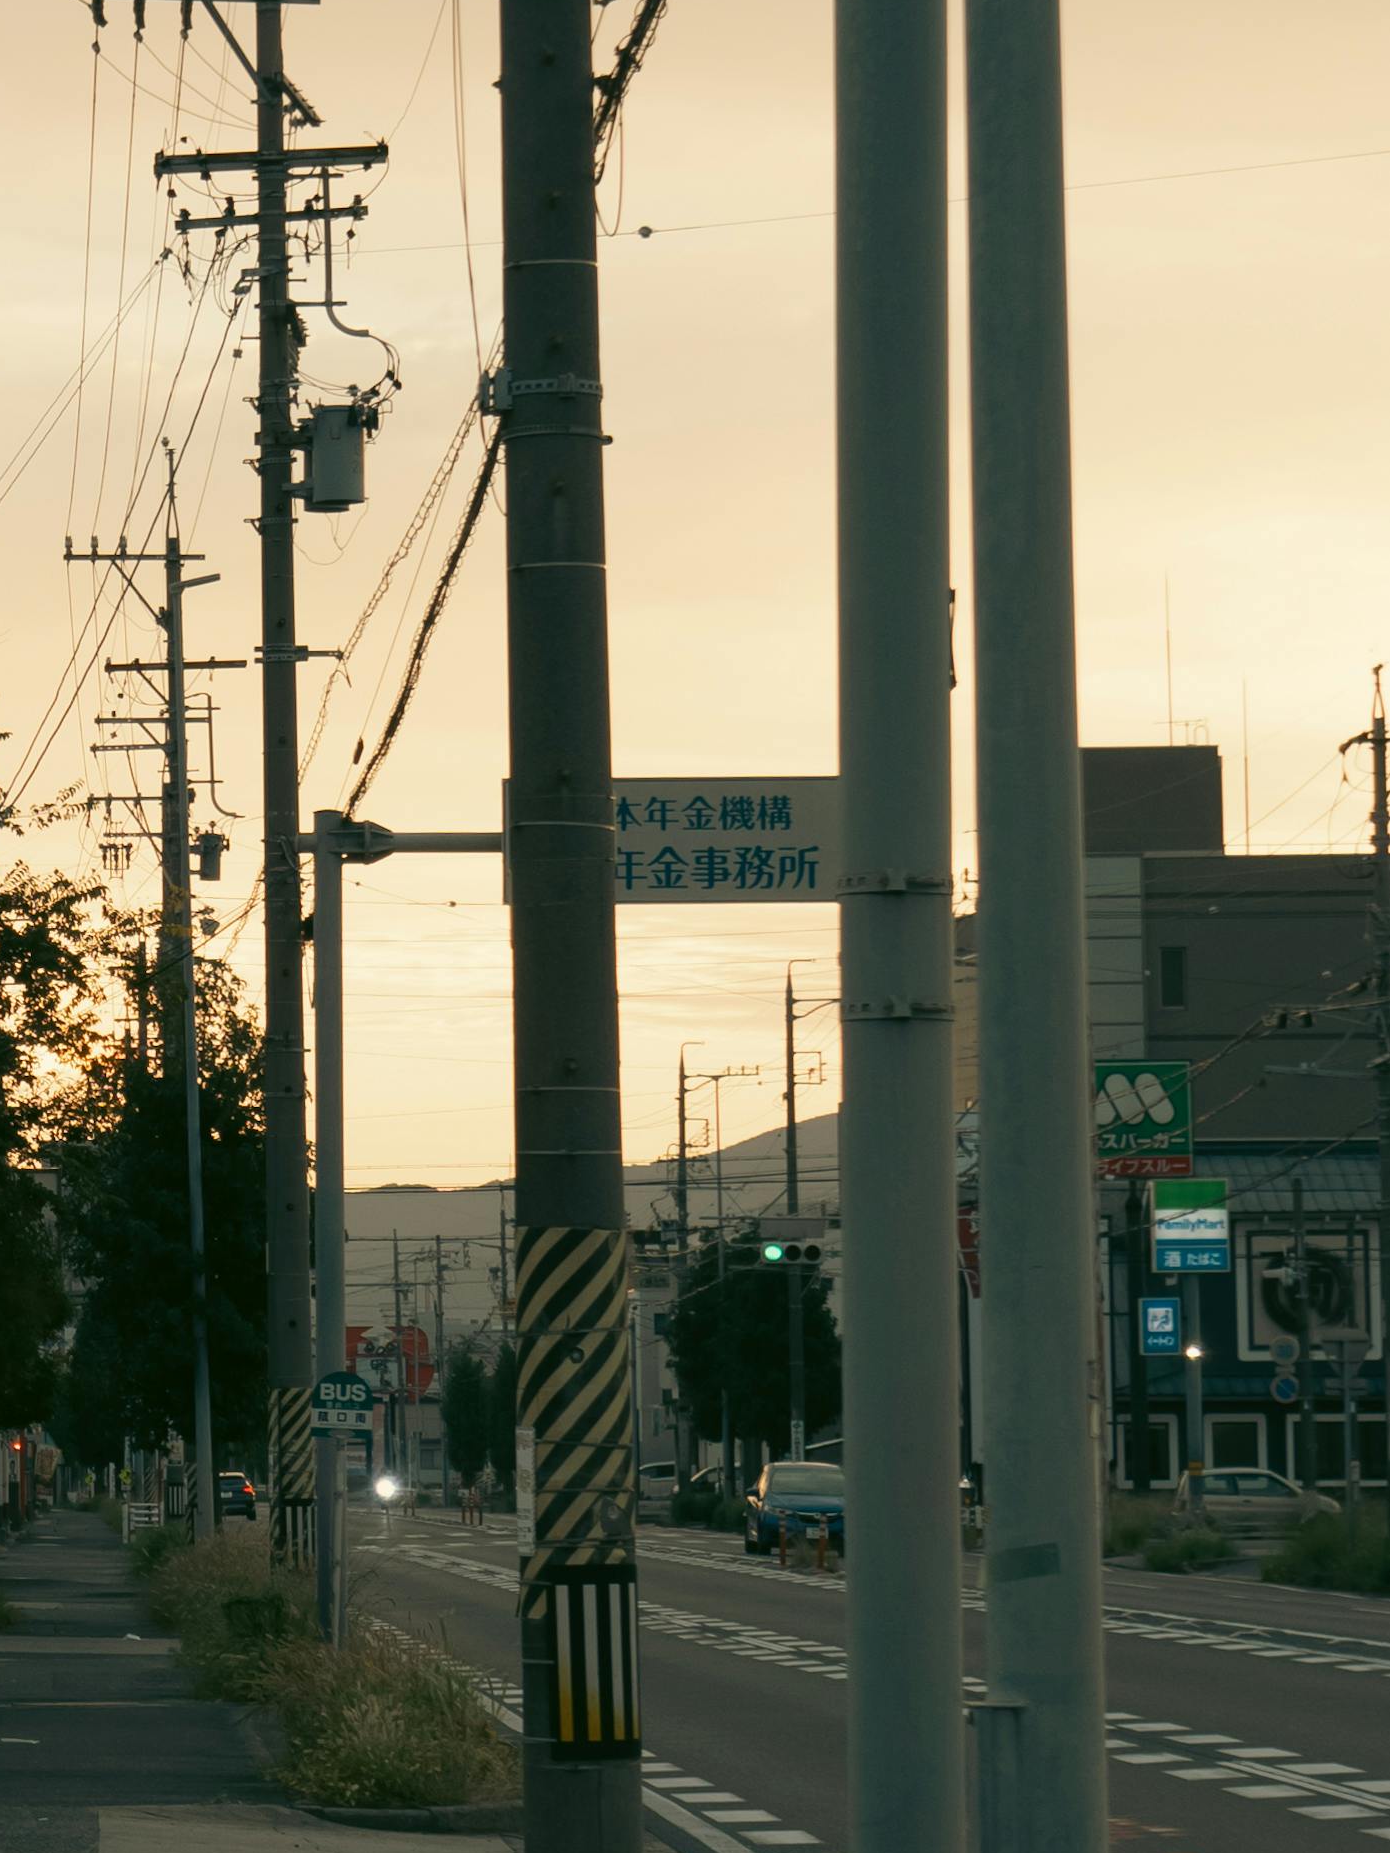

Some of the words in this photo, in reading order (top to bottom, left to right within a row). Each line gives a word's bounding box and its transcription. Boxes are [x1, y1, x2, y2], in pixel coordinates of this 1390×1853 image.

[615, 845, 820, 891] 年金事務所
[1096, 1131, 1186, 1150] スバーガー
[319, 1382, 367, 1402] BUS
